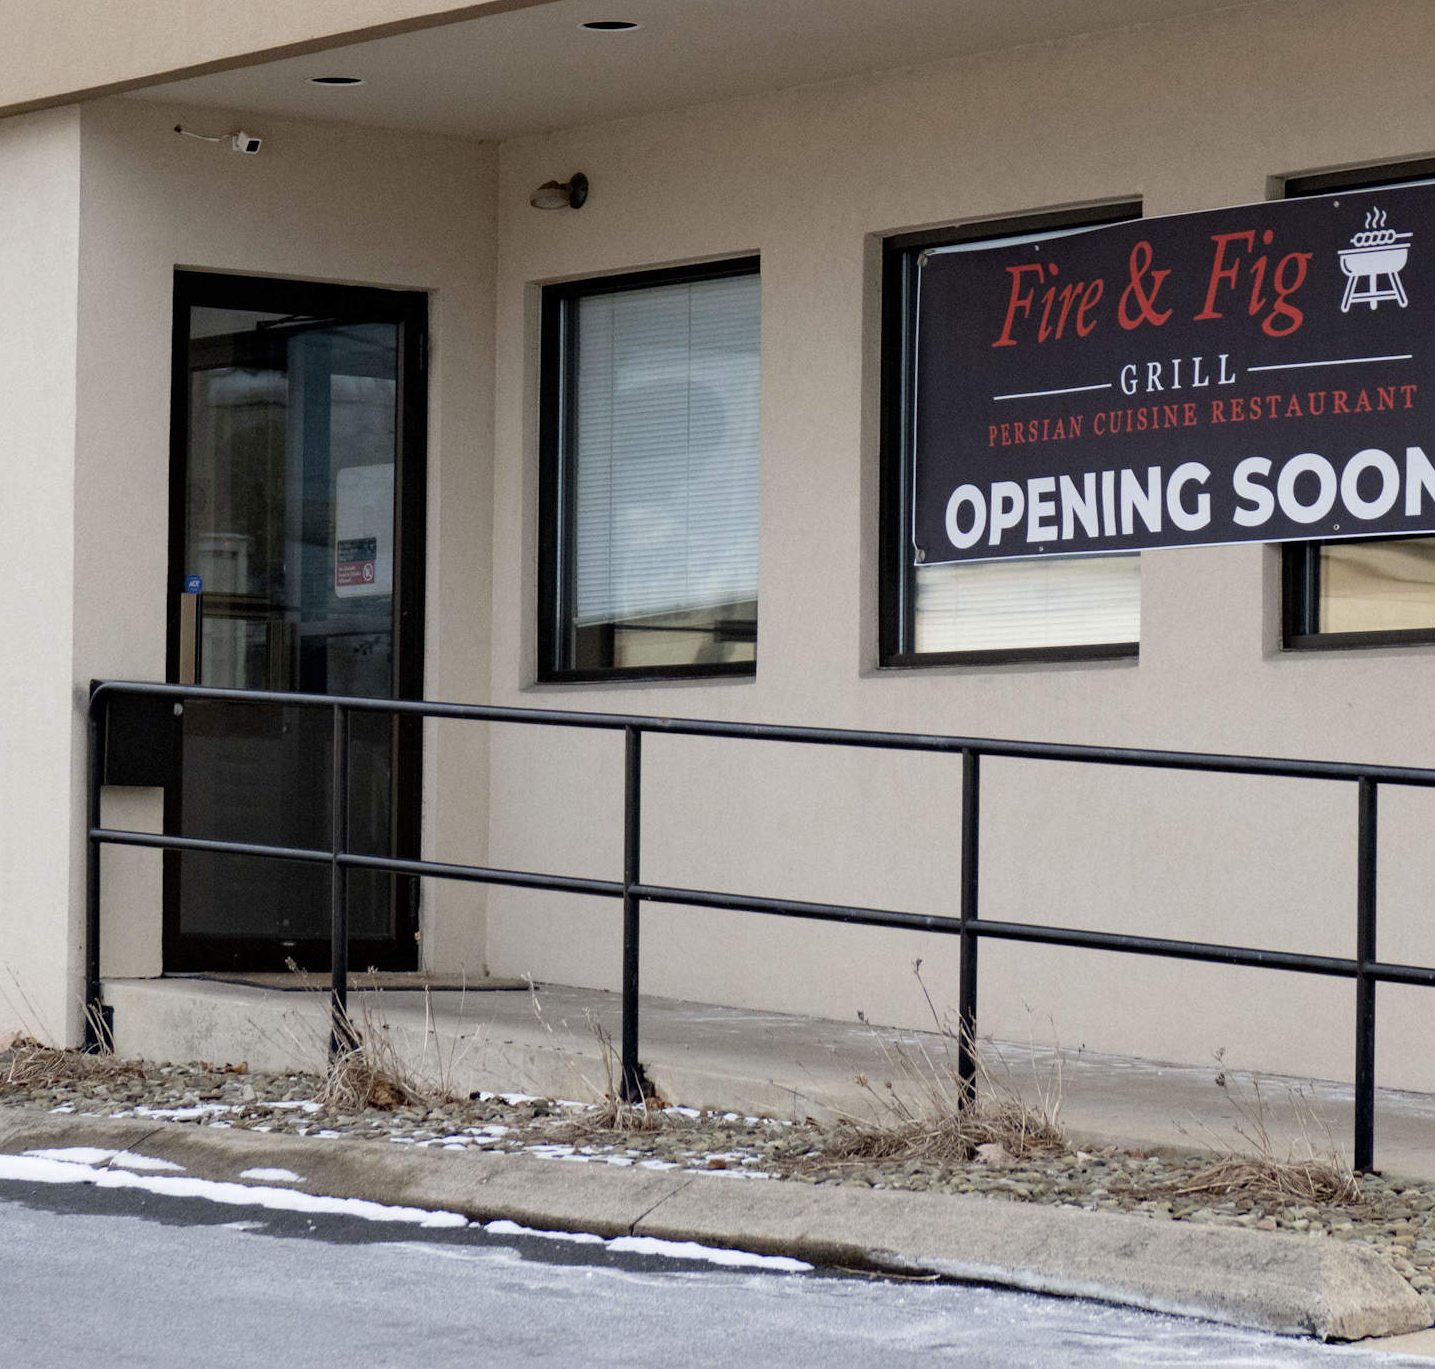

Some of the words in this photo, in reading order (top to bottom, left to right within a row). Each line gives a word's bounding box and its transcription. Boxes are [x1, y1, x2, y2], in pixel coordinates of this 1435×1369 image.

[992, 262, 1104, 348] Fire
[1118, 240, 1172, 330] &
[1194, 229, 1313, 337] Fig
[1120, 353, 1236, 395] GRILL
[988, 414, 1083, 447] PERSIAN
[1092, 401, 1198, 436] CUISINE
[1211, 383, 1418, 424] RESTAURANT
[945, 461, 1212, 550] OPENING
